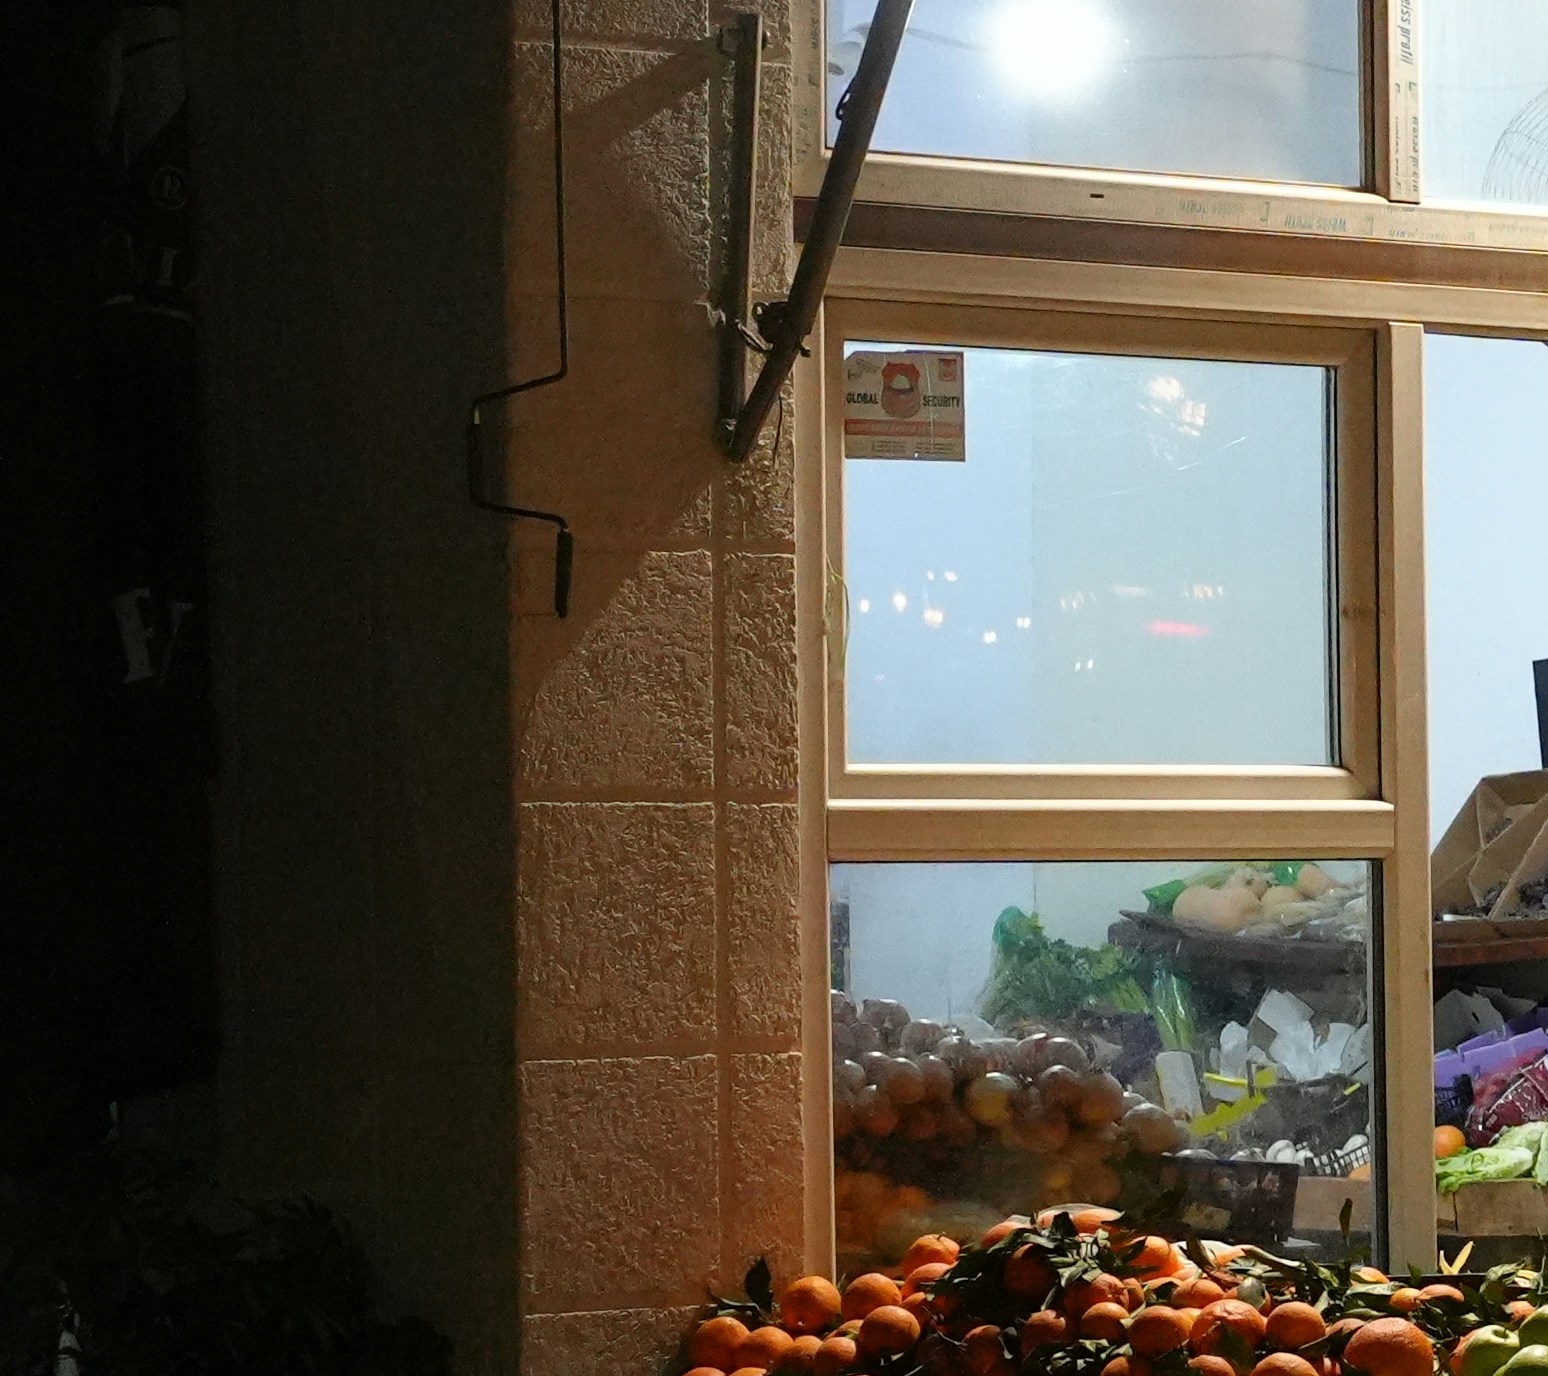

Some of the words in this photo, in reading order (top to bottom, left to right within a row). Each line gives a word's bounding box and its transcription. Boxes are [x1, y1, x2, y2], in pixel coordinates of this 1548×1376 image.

[1397, 25, 1414, 65] profil
[846, 393, 879, 405] GLOBAL
[922, 395, 960, 408] SECURITY
